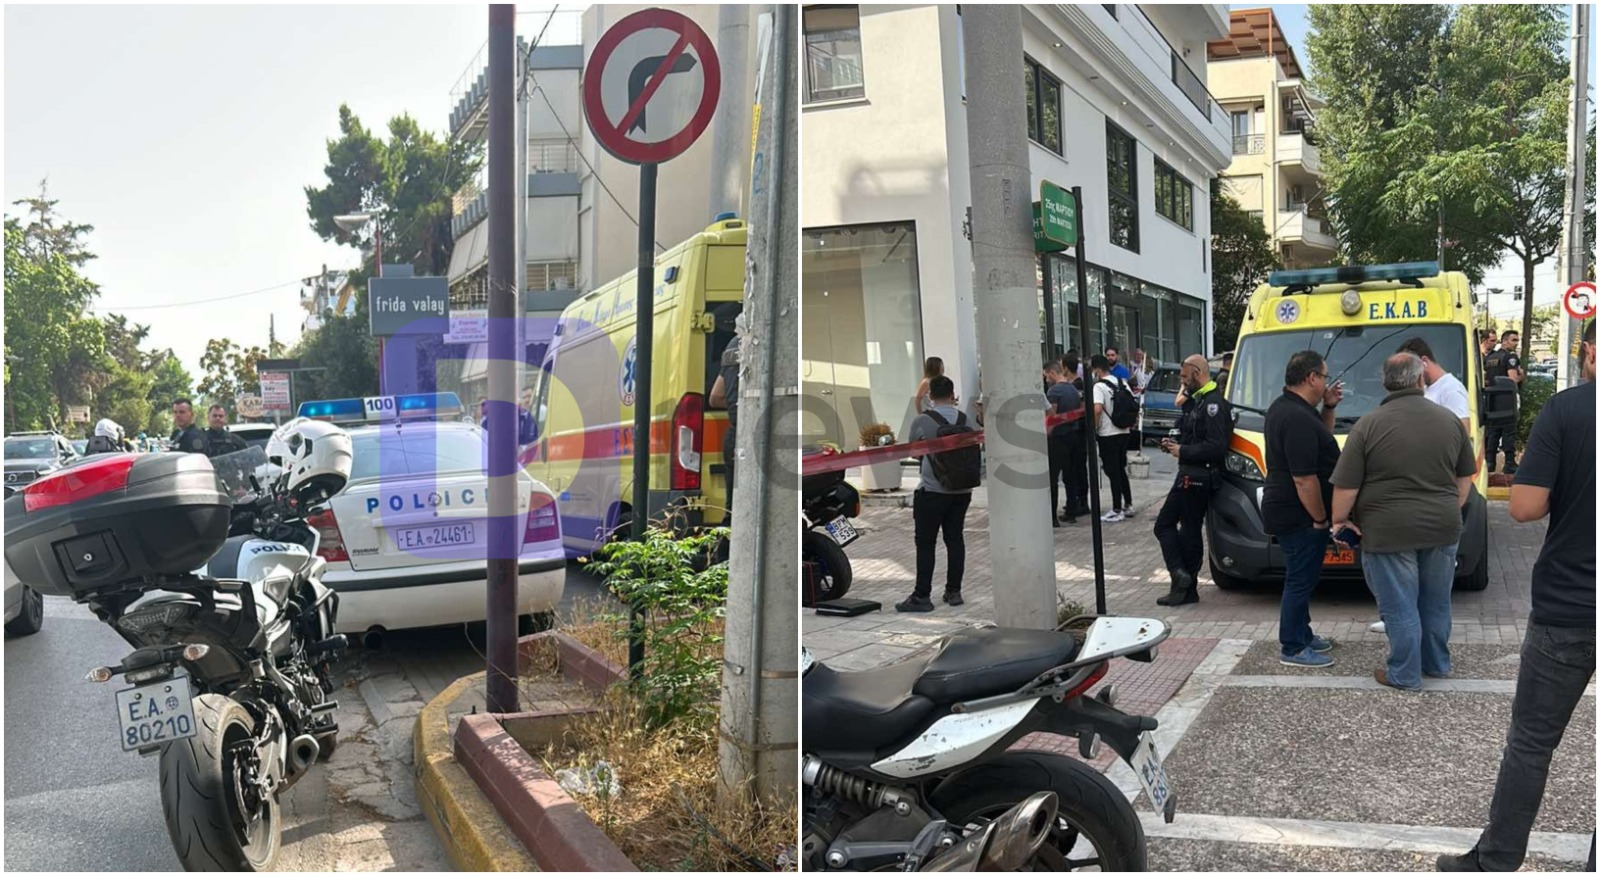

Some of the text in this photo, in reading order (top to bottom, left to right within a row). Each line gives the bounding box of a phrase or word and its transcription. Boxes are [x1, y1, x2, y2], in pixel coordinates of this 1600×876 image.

[376, 295, 445, 316] frida valay
[366, 398, 394, 411] 100
[366, 488, 488, 513] POLIC
[433, 526, 468, 544] 24461
[125, 714, 191, 746] 80210
